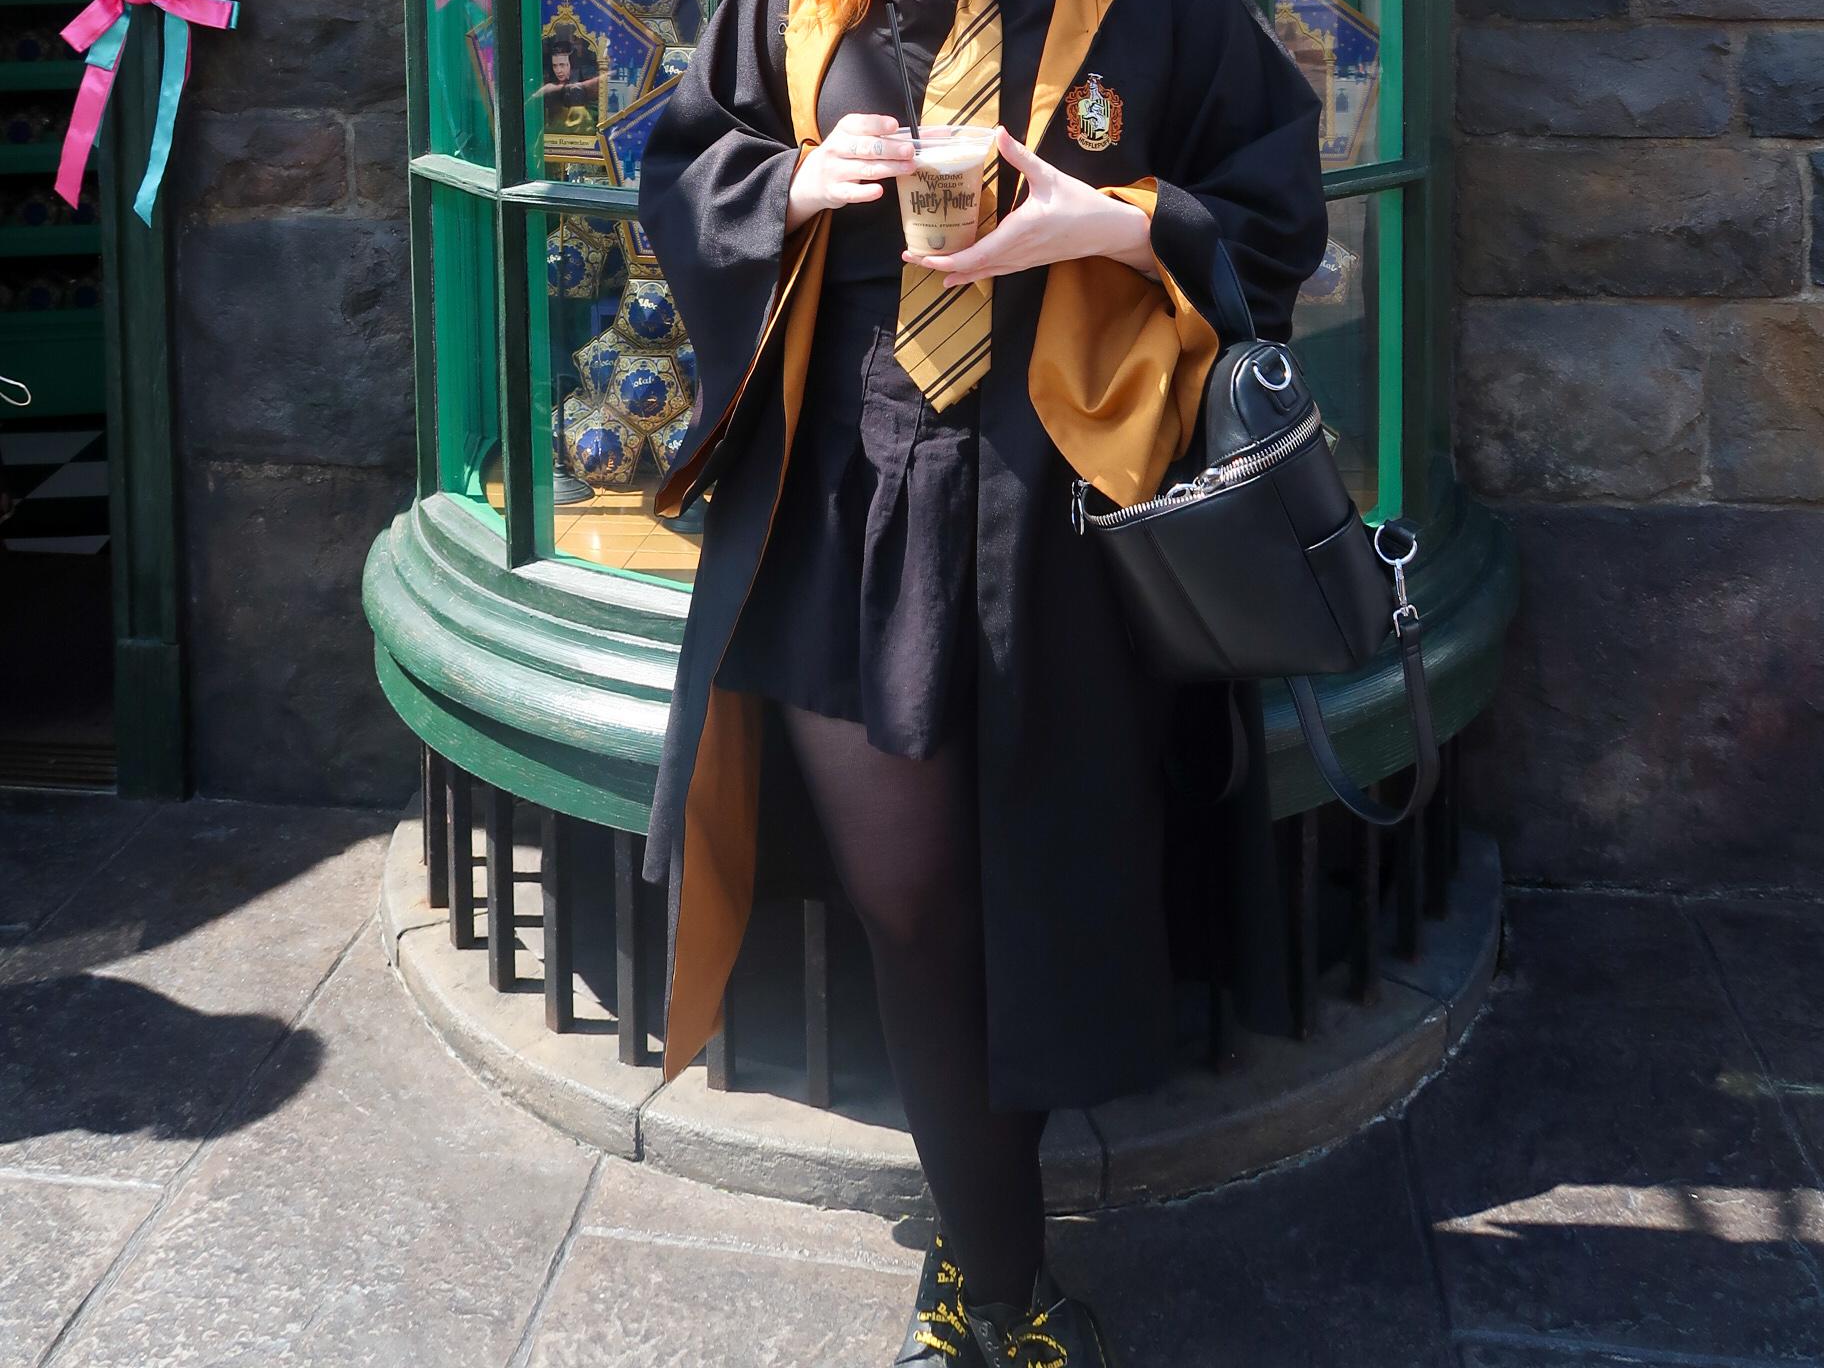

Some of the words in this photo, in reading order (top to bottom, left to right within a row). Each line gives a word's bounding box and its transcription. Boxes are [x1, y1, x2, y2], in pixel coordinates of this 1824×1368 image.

[1078, 136, 1111, 149] HUFFLEPUFF
[916, 170, 963, 182] WIZARDING
[926, 180, 957, 192] WORLD
[910, 190, 942, 216] Harry
[942, 189, 976, 223] Potter
